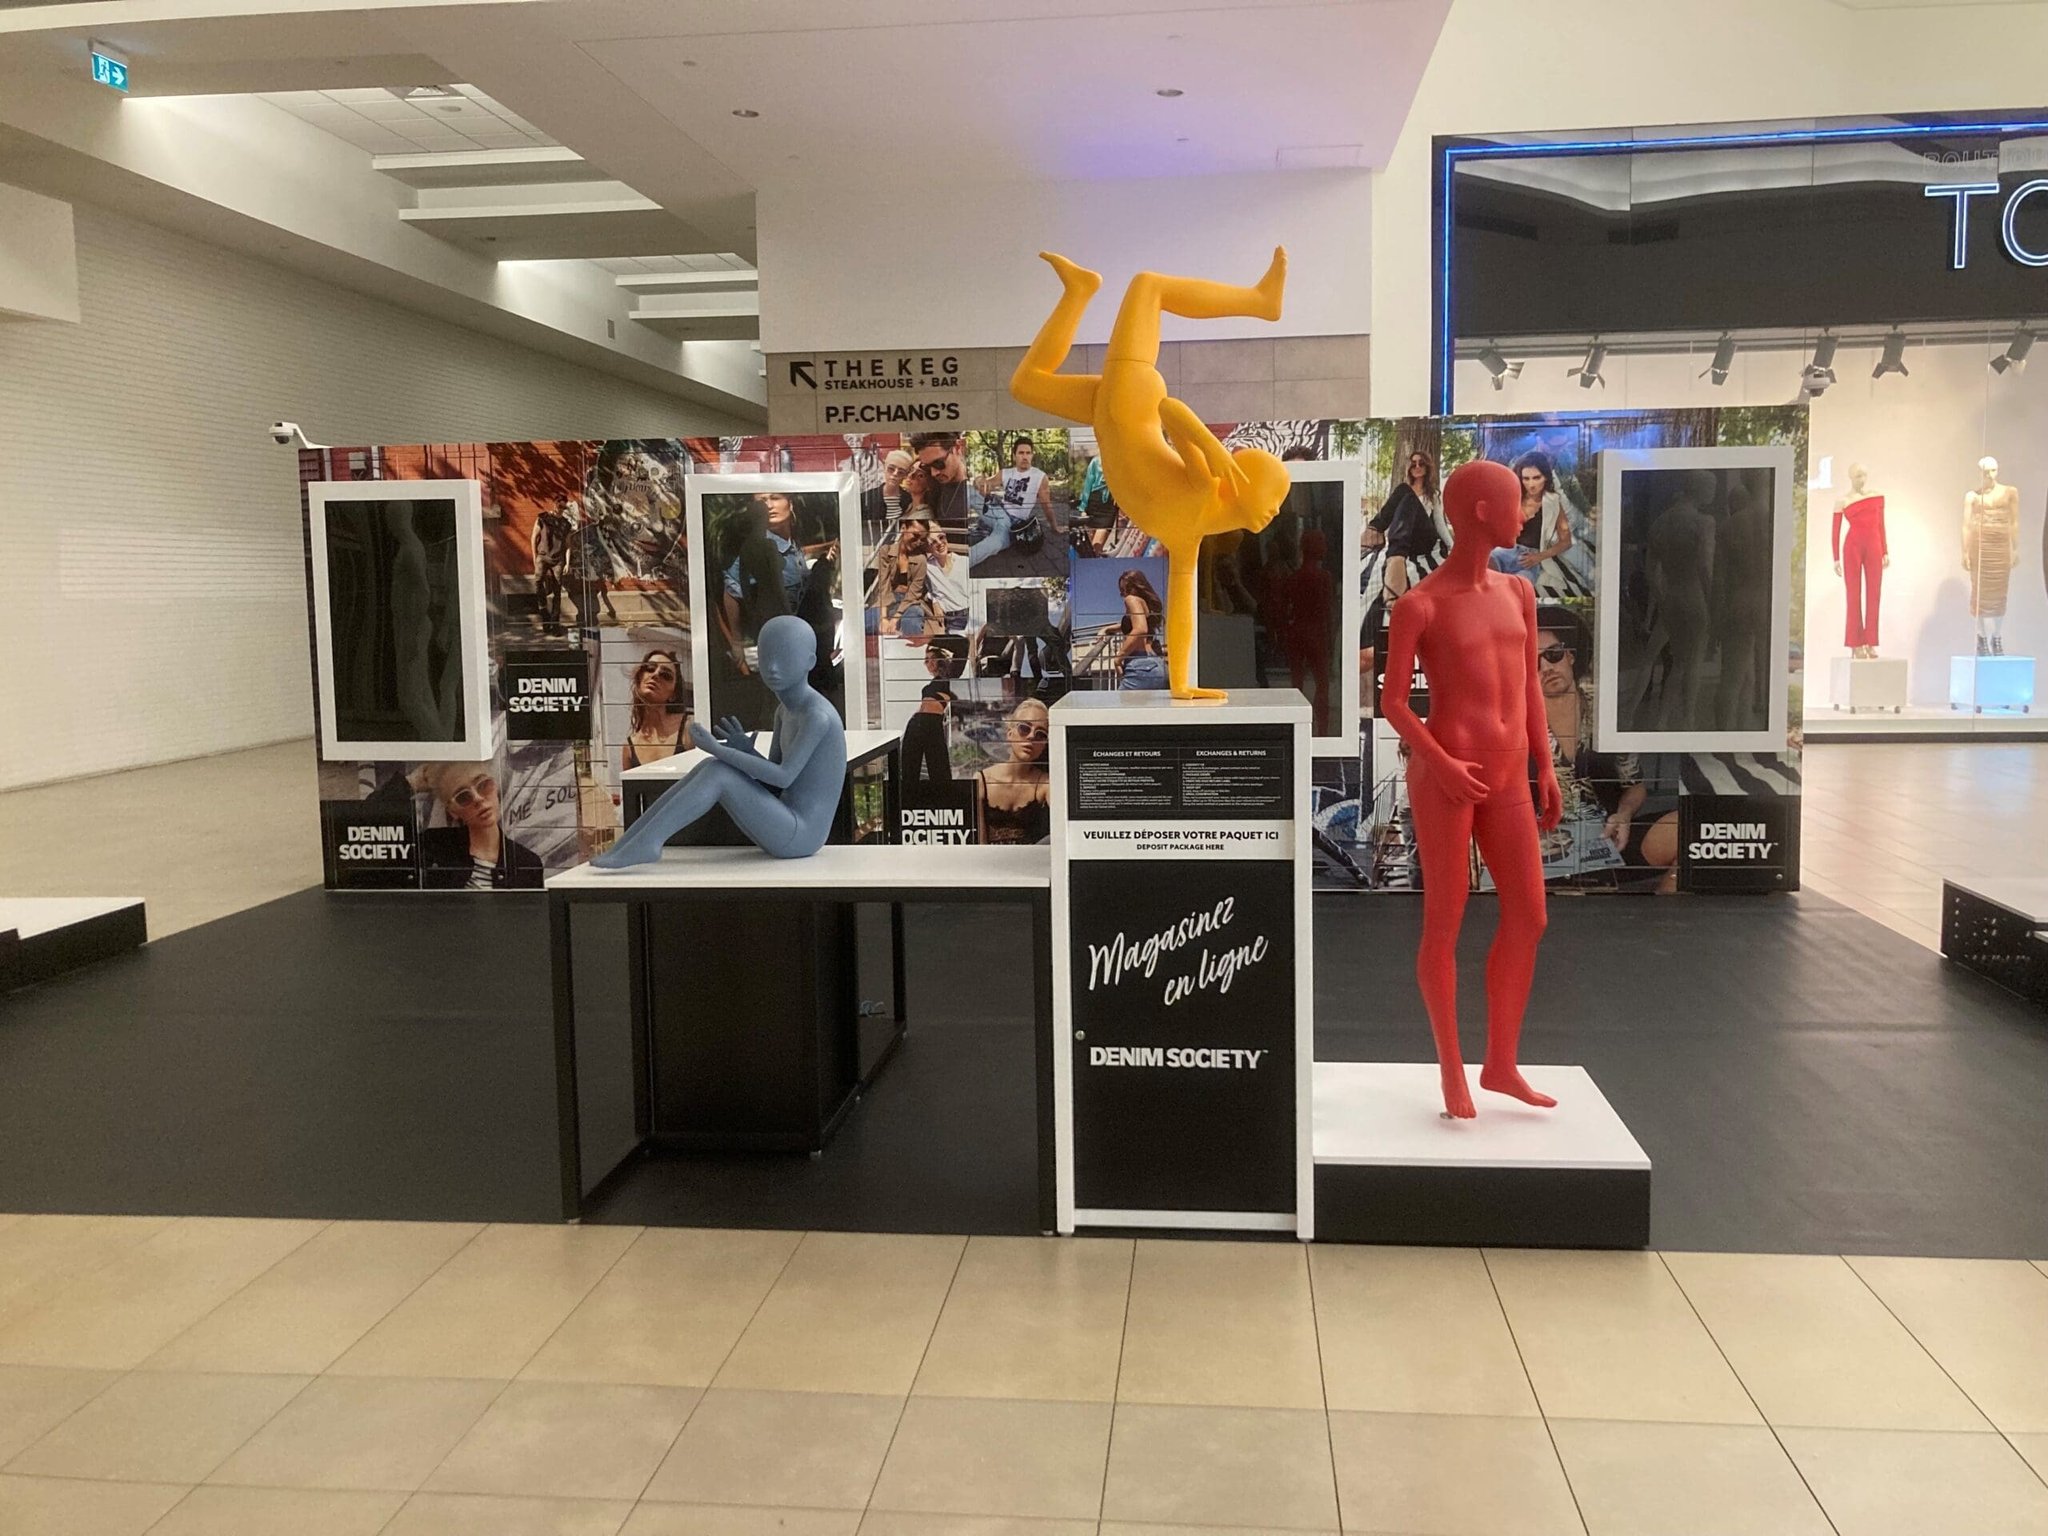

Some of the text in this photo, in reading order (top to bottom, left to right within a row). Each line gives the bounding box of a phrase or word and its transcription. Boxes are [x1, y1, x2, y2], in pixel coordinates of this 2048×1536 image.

[1924, 179, 2048, 269] TO
[824, 356, 959, 378] THE KEG
[824, 378, 913, 390] STEAKHOUSE
[931, 377, 959, 387] BAR
[517, 677, 577, 694] DENIM
[508, 696, 583, 712] SOCIETY
[509, 801, 532, 826] ME
[901, 809, 964, 826] DENIM
[347, 826, 405, 842] DENIM
[888, 829, 971, 845] OCIETY
[1083, 829, 1279, 841] VEUILLEZ DÉPOSER VOTRE PAQUET ICI
[1700, 823, 1766, 839] DENIM
[339, 843, 411, 860] SOCIETY
[1688, 842, 1772, 859] SOCIETY
[1088, 896, 1235, 991] Magasinez
[1164, 935, 1269, 1006] en ligne
[1090, 1046, 1262, 1069] DENIM SOCIETY
